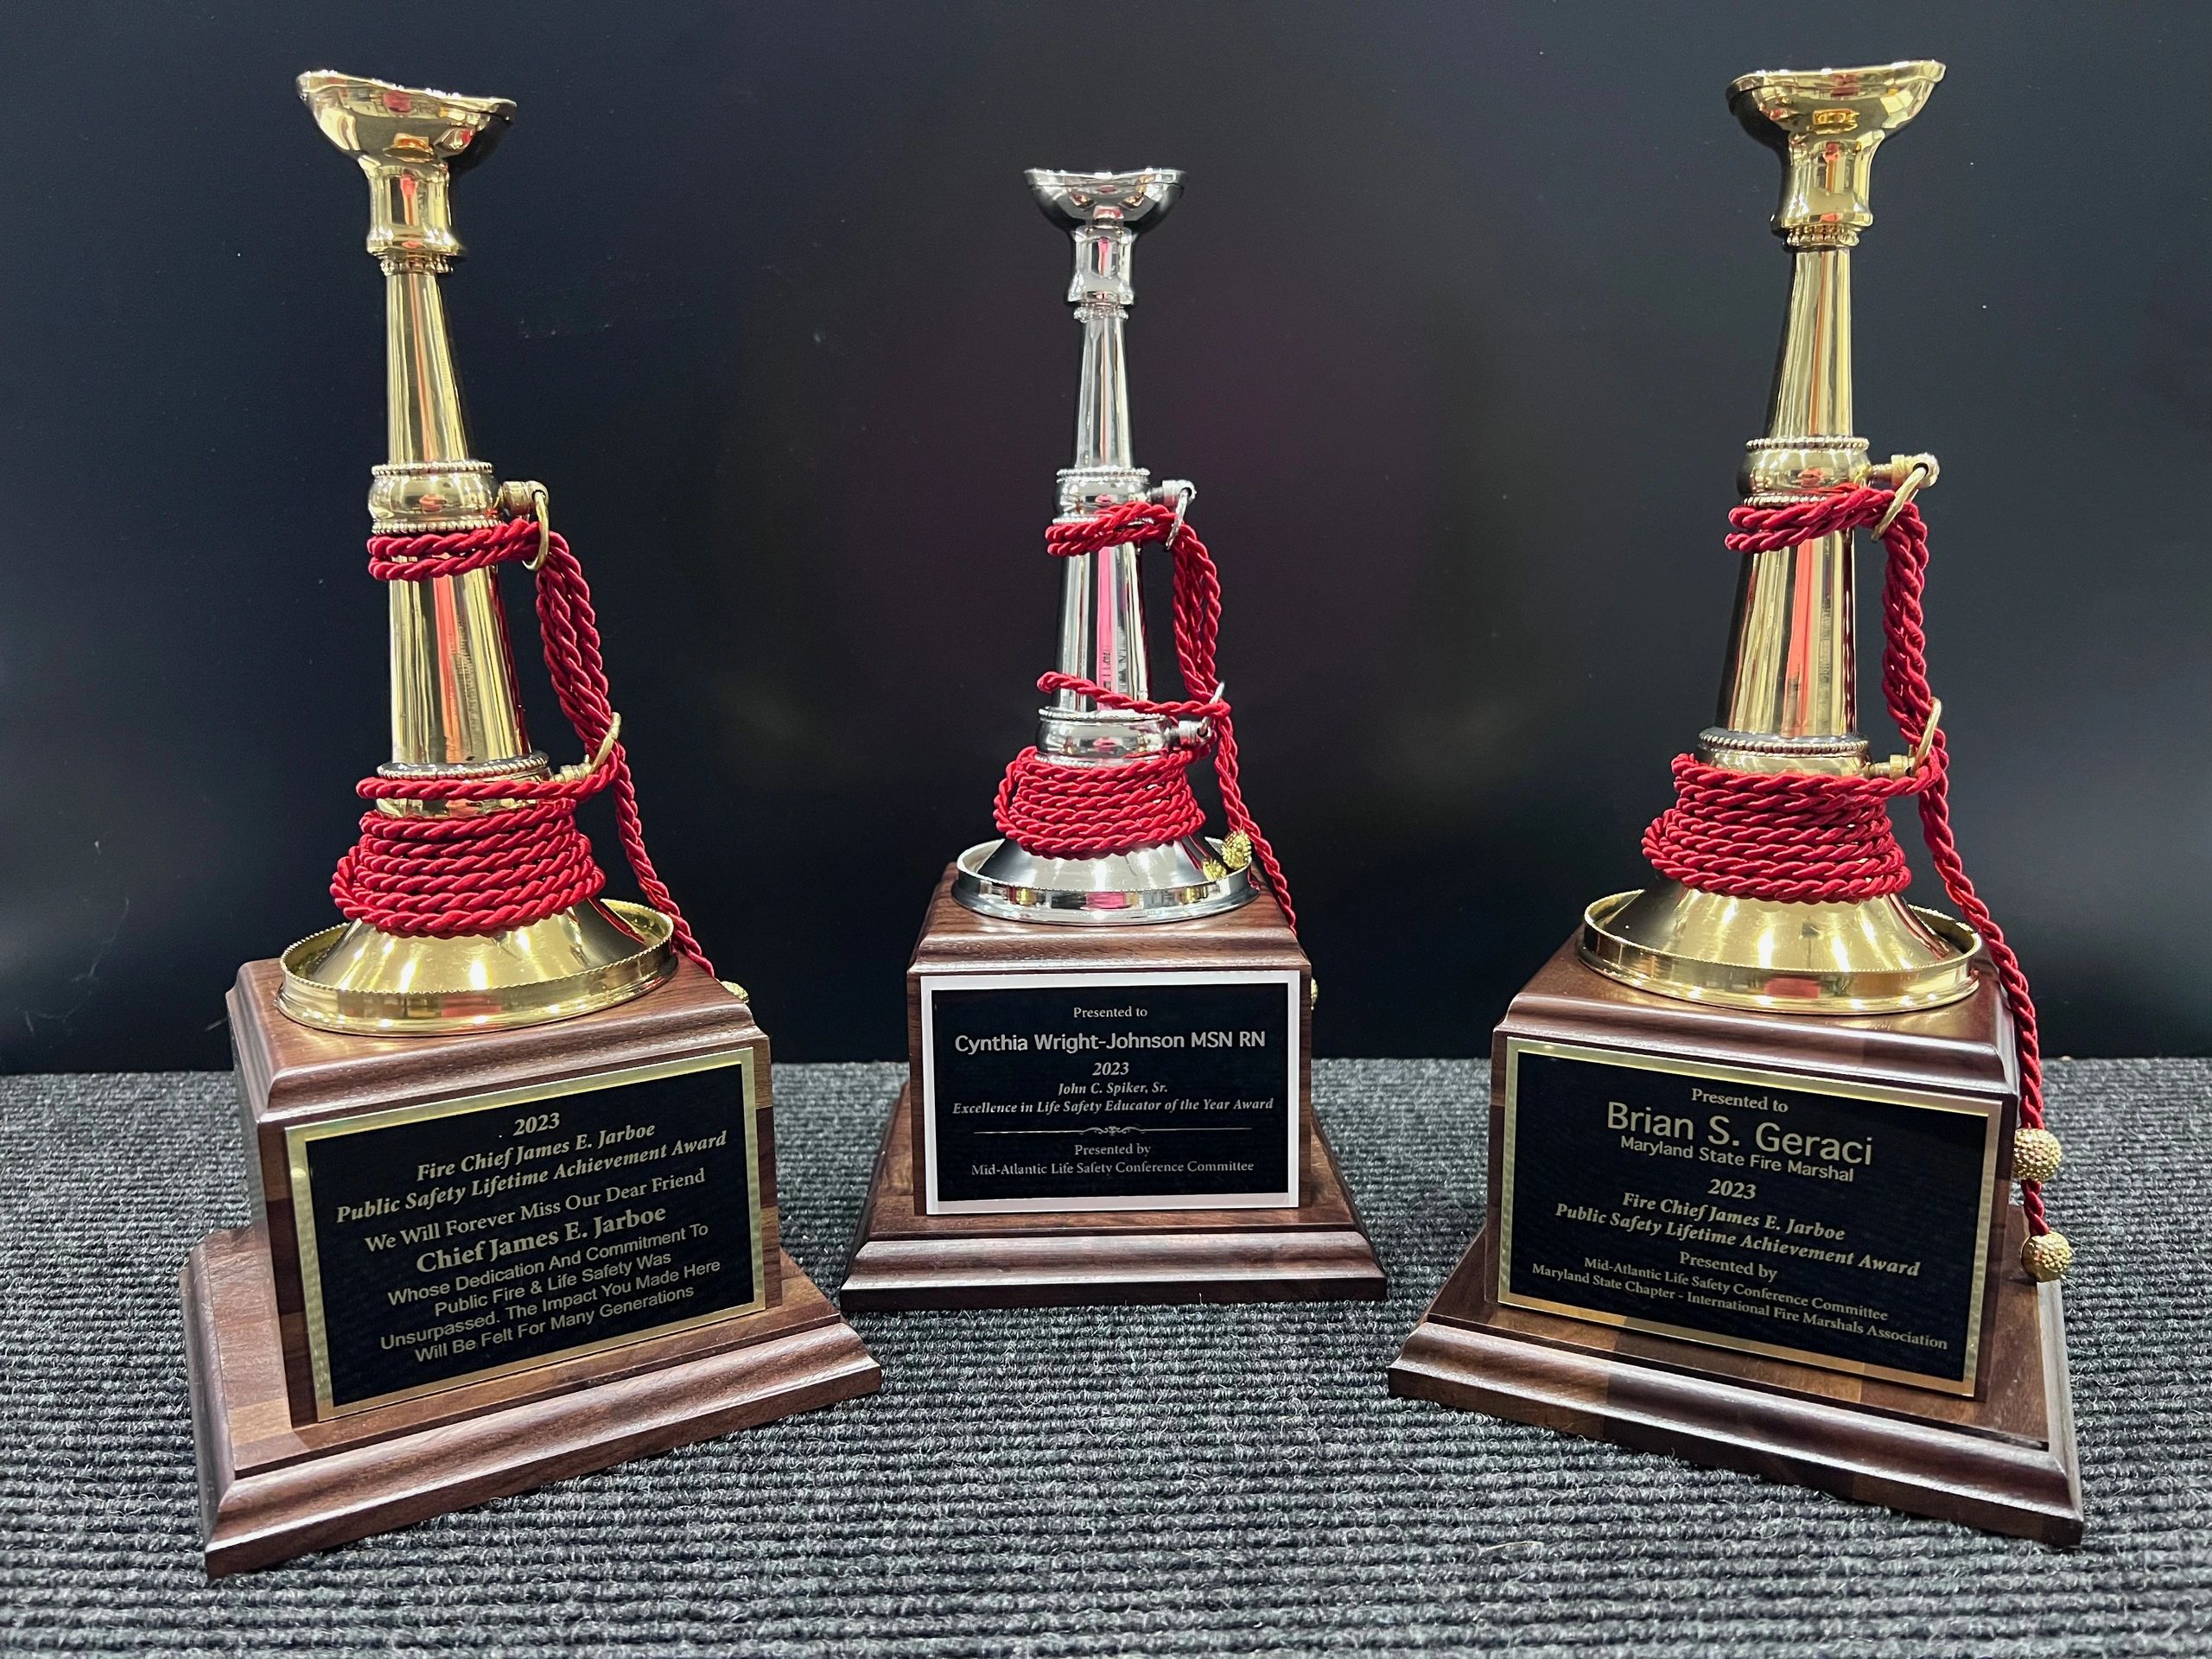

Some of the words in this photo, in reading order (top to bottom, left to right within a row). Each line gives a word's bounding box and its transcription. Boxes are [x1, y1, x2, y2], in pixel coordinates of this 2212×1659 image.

[1074, 1006, 1132, 1018] Presented
[1135, 1007, 1147, 1017] to
[955, 1034, 1028, 1055] Cynthia
[1034, 1032, 1185, 1054] Wright-Johnson
[1192, 1032, 1232, 1048] MSN
[1240, 1031, 1265, 1047] RN
[1058, 1083, 1086, 1096] John
[1090, 1083, 1103, 1094] C.
[1106, 1082, 1147, 1096] Spiker,
[1152, 1082, 1167, 1093] Sr.
[1092, 1062, 1128, 1076] 2023
[512, 1112, 560, 1136] 2023
[952, 1102, 1017, 1114] Excellence
[1020, 1102, 1033, 1112] in
[1037, 1101, 1060, 1116] Life
[1063, 1100, 1102, 1115] Safety
[1105, 1099, 1161, 1111] Educator
[1165, 1099, 1179, 1113] of
[1180, 1099, 1199, 1109] the
[1204, 1099, 1230, 1109] Year
[1233, 1097, 1274, 1109] Award
[1692, 1088, 1768, 1110] Presented
[1773, 1100, 1789, 1112] to
[417, 1163, 455, 1181] Fire
[461, 1147, 514, 1172] Chief
[515, 1141, 569, 1165] James
[575, 1134, 592, 1150] E.
[597, 1125, 655, 1149] Jarboe
[1075, 1143, 1133, 1155] Presented
[1136, 1143, 1151, 1157] by
[1608, 1102, 1694, 1140] Brian
[1708, 1116, 1739, 1146] S.
[1756, 1122, 1872, 1165] Geraci
[337, 1198, 400, 1223] Public
[405, 1186, 466, 1210] Safety
[471, 1171, 548, 1198] Lifetime
[553, 1144, 667, 1179] Achievement
[671, 1130, 727, 1155] Award
[972, 1163, 1047, 1175] Mid-Atlantic
[1052, 1162, 1073, 1173] Life
[1077, 1161, 1112, 1176] Safety
[1116, 1161, 1184, 1173] Conference
[1187, 1161, 1254, 1172] Committee
[1621, 1135, 1693, 1158] Maryland
[1699, 1147, 1745, 1166] State
[1751, 1154, 1782, 1171] Fire
[1788, 1160, 1853, 1182] Marshal
[365, 1234, 396, 1251] We
[400, 1223, 441, 1244] Will
[446, 1212, 516, 1236] Forever
[520, 1202, 561, 1220] Miss
[565, 1194, 601, 1210] Our
[606, 1185, 647, 1202] Dear
[652, 1167, 705, 1192] Friend
[1707, 1179, 1756, 1199] 2023
[416, 1241, 486, 1272] Chief
[489, 1231, 559, 1262] James
[564, 1221, 588, 1241] E.
[594, 1208, 665, 1239] Jarboe
[1555, 1204, 1607, 1224] Public
[1610, 1212, 1662, 1236] Safety
[1665, 1222, 1736, 1245] Lifetime
[1739, 1235, 1853, 1265] Achievement
[1858, 1255, 1921, 1276] Award
[1623, 1192, 1656, 1210] Fire
[1661, 1199, 1708, 1221] Chief
[1707, 1206, 1759, 1226] James
[1764, 1215, 1780, 1230] E.
[1785, 1218, 1845, 1240] Jarboe
[388, 1283, 450, 1306] Whose
[455, 1262, 544, 1291] Dedication
[549, 1250, 581, 1270] And
[586, 1228, 686, 1261] Commitment
[690, 1224, 708, 1237] To
[435, 1294, 487, 1317] Public
[493, 1287, 524, 1303] Fire
[531, 1281, 543, 1294] &
[548, 1274, 577, 1290] Life
[582, 1262, 632, 1282] Safety
[636, 1254, 671, 1269] Was
[1585, 1257, 1662, 1280] Mid-Atlantic
[1665, 1272, 1688, 1285] Life
[1692, 1276, 1730, 1294] Safety
[1733, 1284, 1808, 1306] Conference
[1812, 1298, 1888, 1320] Committee
[1680, 1251, 1753, 1275] Presented
[1758, 1264, 1777, 1282] by
[381, 1311, 500, 1349] Unsurpassed.
[505, 1305, 537, 1319] The
[543, 1288, 598, 1312] Impact
[601, 1282, 631, 1297] You
[636, 1270, 679, 1289] Made
[684, 1262, 720, 1278] Here
[415, 1343, 448, 1362] Will
[453, 1339, 476, 1353] Be
[481, 1328, 513, 1346] Felt
[518, 1322, 546, 1338] For
[551, 1311, 594, 1330] Many
[600, 1287, 694, 1317] Generations
[1533, 1263, 1589, 1283] Maryland
[1592, 1275, 1622, 1289] State
[1625, 1281, 1675, 1299] Chapter
[1688, 1292, 1770, 1316] International
[1774, 1307, 1799, 1321] Fire
[1802, 1313, 1864, 1333] Marshals
[1866, 1325, 1947, 1350] Association
